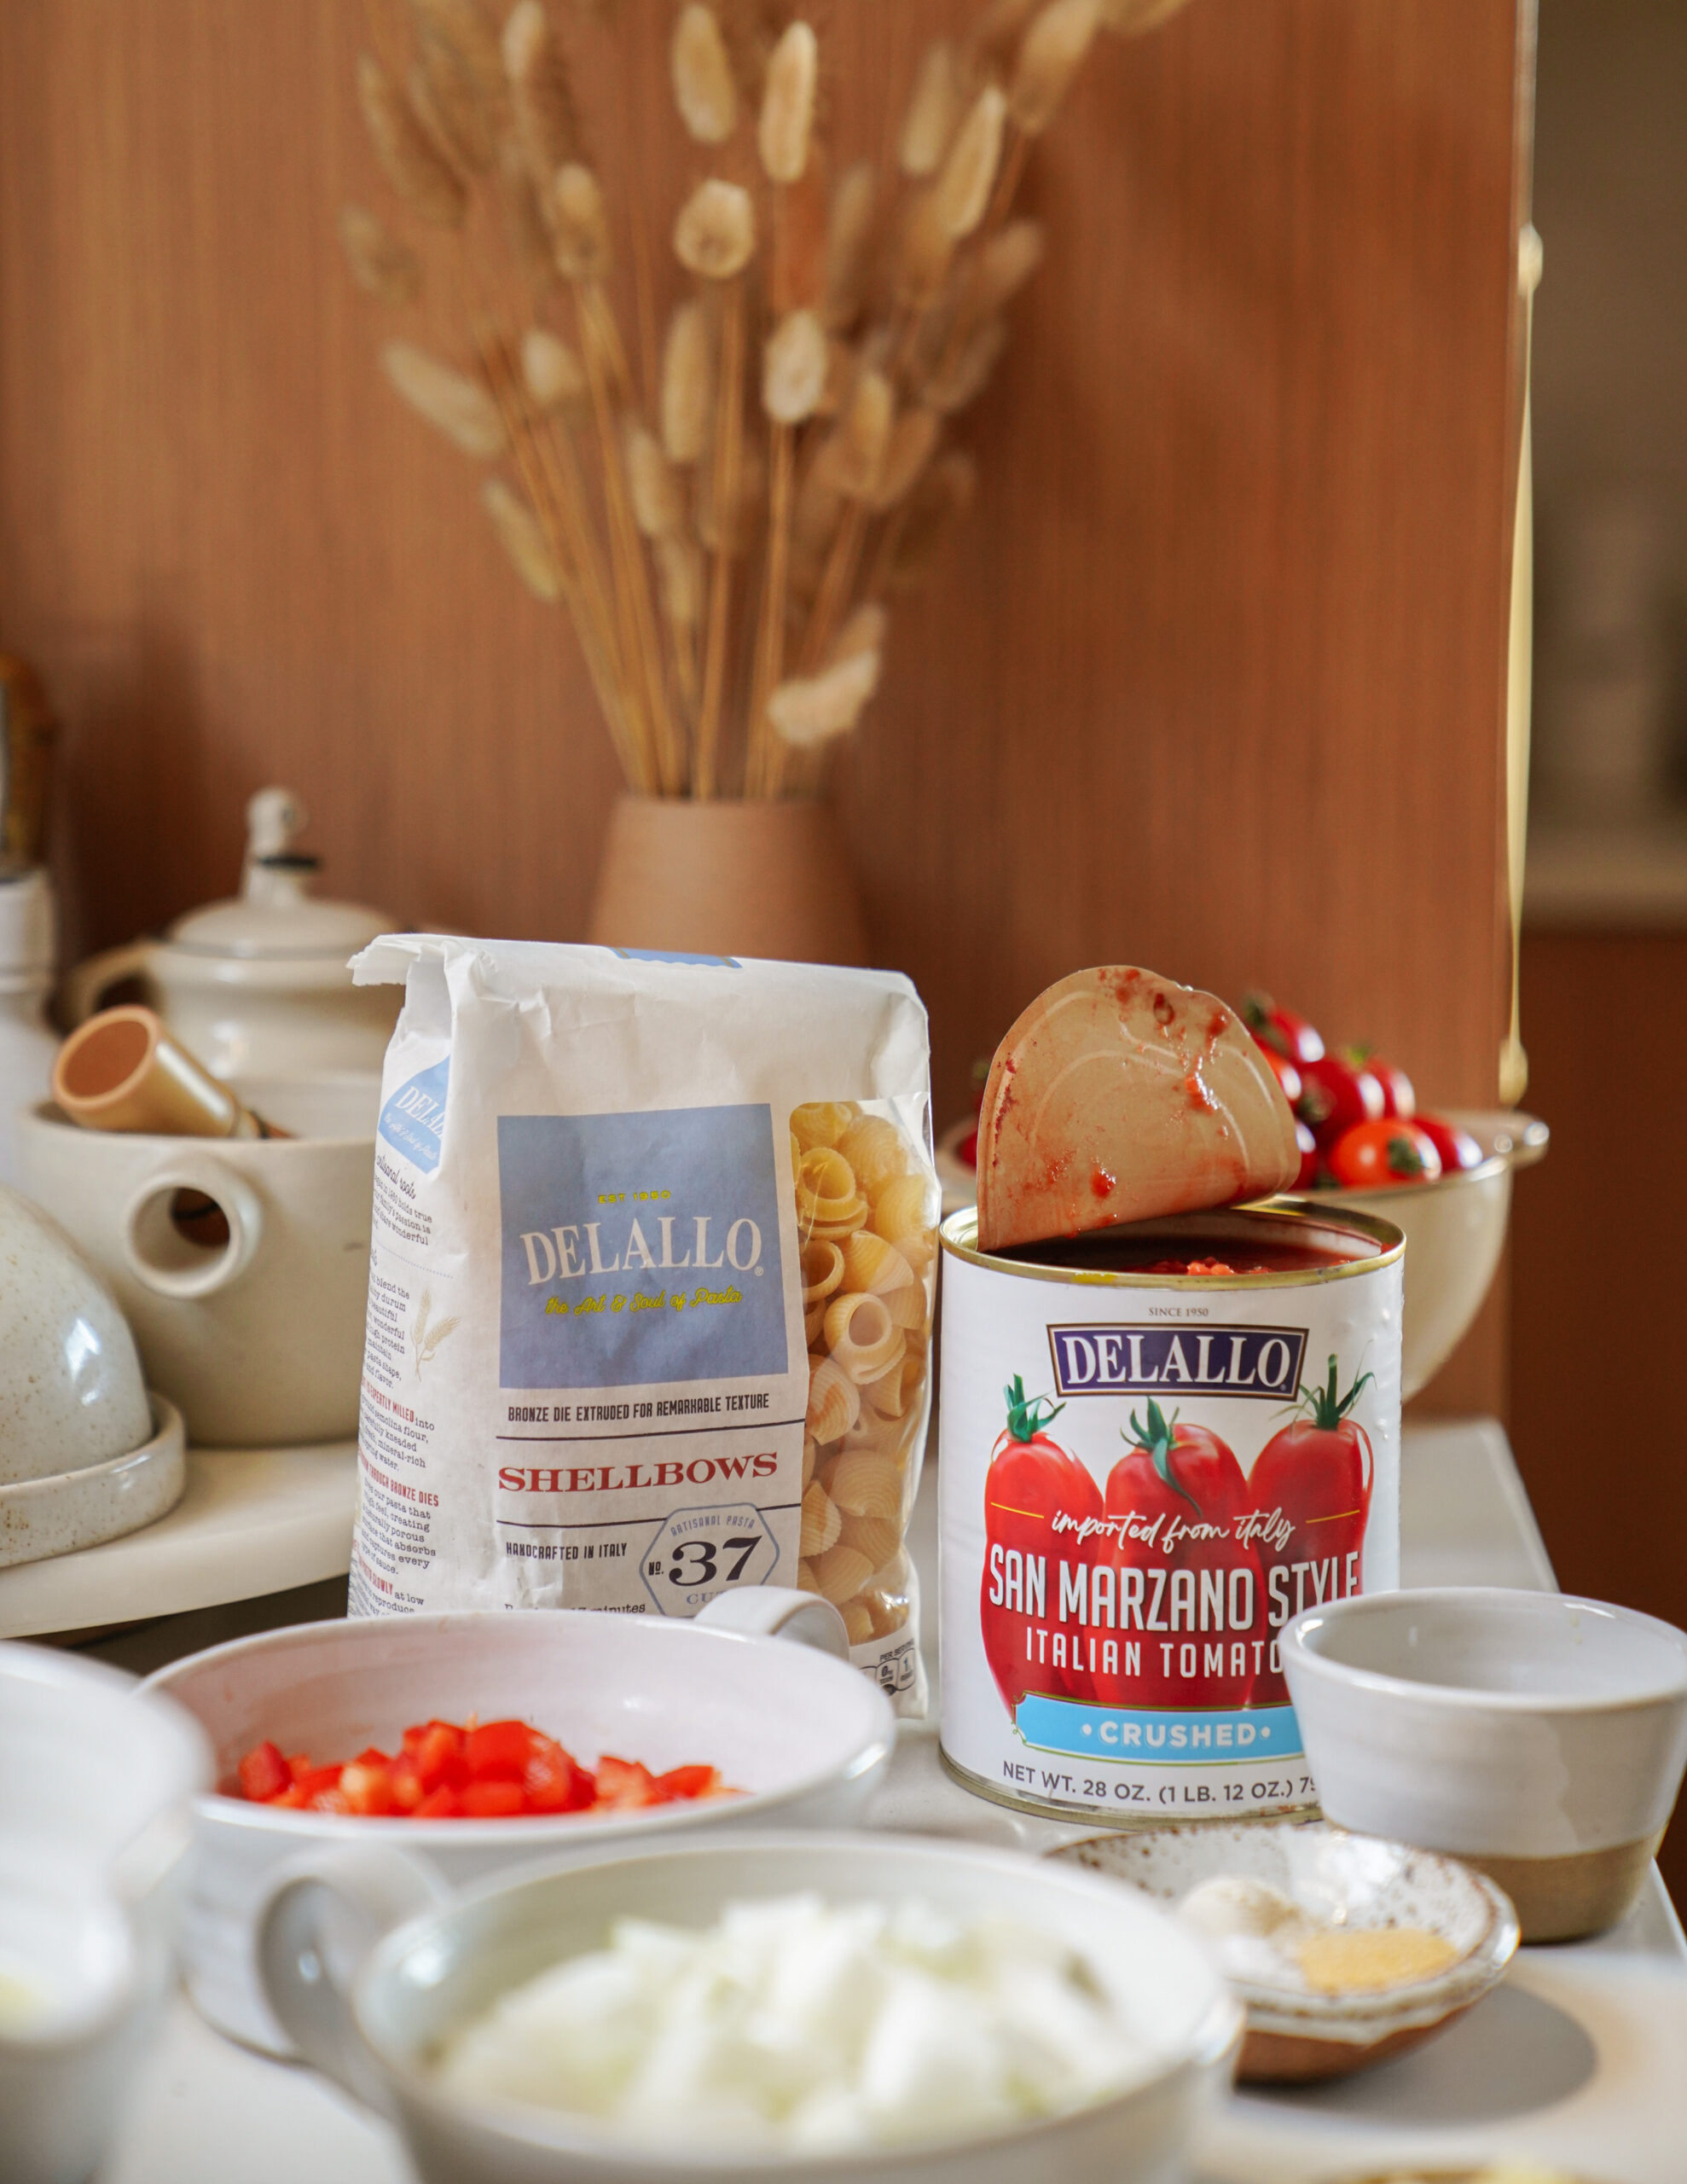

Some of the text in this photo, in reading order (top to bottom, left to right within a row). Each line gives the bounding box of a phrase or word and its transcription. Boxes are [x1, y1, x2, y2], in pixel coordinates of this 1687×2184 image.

[599, 1190, 671, 1205] EST 1950
[415, 1210, 432, 1223] true
[391, 1223, 429, 1246] wonderful
[423, 1224, 431, 1234] is
[376, 1276, 397, 1293] blend
[397, 1287, 410, 1299] the
[381, 1292, 406, 1312] durum
[545, 1285, 743, 1316] the Art & Soul of Pasta
[1148, 1307, 1209, 1317] SINCE 1950
[381, 1334, 405, 1355] protein
[382, 1362, 402, 1381] shape,
[392, 1401, 415, 1423] MILLED
[415, 1417, 435, 1431] into
[507, 1392, 770, 1423] BRONZE DIE EXTRUDED FOR REMARKABLE TEXTURE
[374, 1409, 403, 1433] semolina
[403, 1426, 429, 1443] flour,
[385, 1428, 417, 1452] kneaded
[378, 1438, 426, 1468] mineral-rich
[379, 1453, 400, 1472] water.
[498, 1451, 779, 1494] SHELLBOWS
[390, 1478, 416, 1502] BRONZE
[418, 1490, 439, 1507] DIES
[386, 1496, 408, 1514] pasta
[409, 1506, 432, 1519] that
[390, 1513, 431, 1534] creating
[391, 1526, 426, 1543] porous
[670, 1513, 756, 1537] ARTISANAL PASTA
[1051, 1507, 1296, 1554] imported from italy
[394, 1542, 437, 1557] absorbs
[506, 1542, 628, 1561] HANDCRAFTED IN ITALY
[375, 1557, 399, 1576] sauce.
[398, 1555, 431, 1570] every
[668, 1535, 763, 1588] 37
[394, 1591, 405, 1602] at
[407, 1593, 425, 1606] low
[988, 1543, 1047, 1619] SAN
[1058, 1559, 1255, 1633] MARZANO
[1026, 1626, 1141, 1677] ITALIAN
[1003, 1760, 1036, 1785] NET
[1041, 1771, 1077, 1794] WT.
[1083, 1779, 1107, 1797] 28
[1114, 1783, 1151, 1802] OZ.
[1159, 1785, 1175, 1805] (1
[1184, 1786, 1217, 1803] LB.
[1226, 1784, 1244, 1801] 12
[1251, 1780, 1294, 1799] OZ.)
